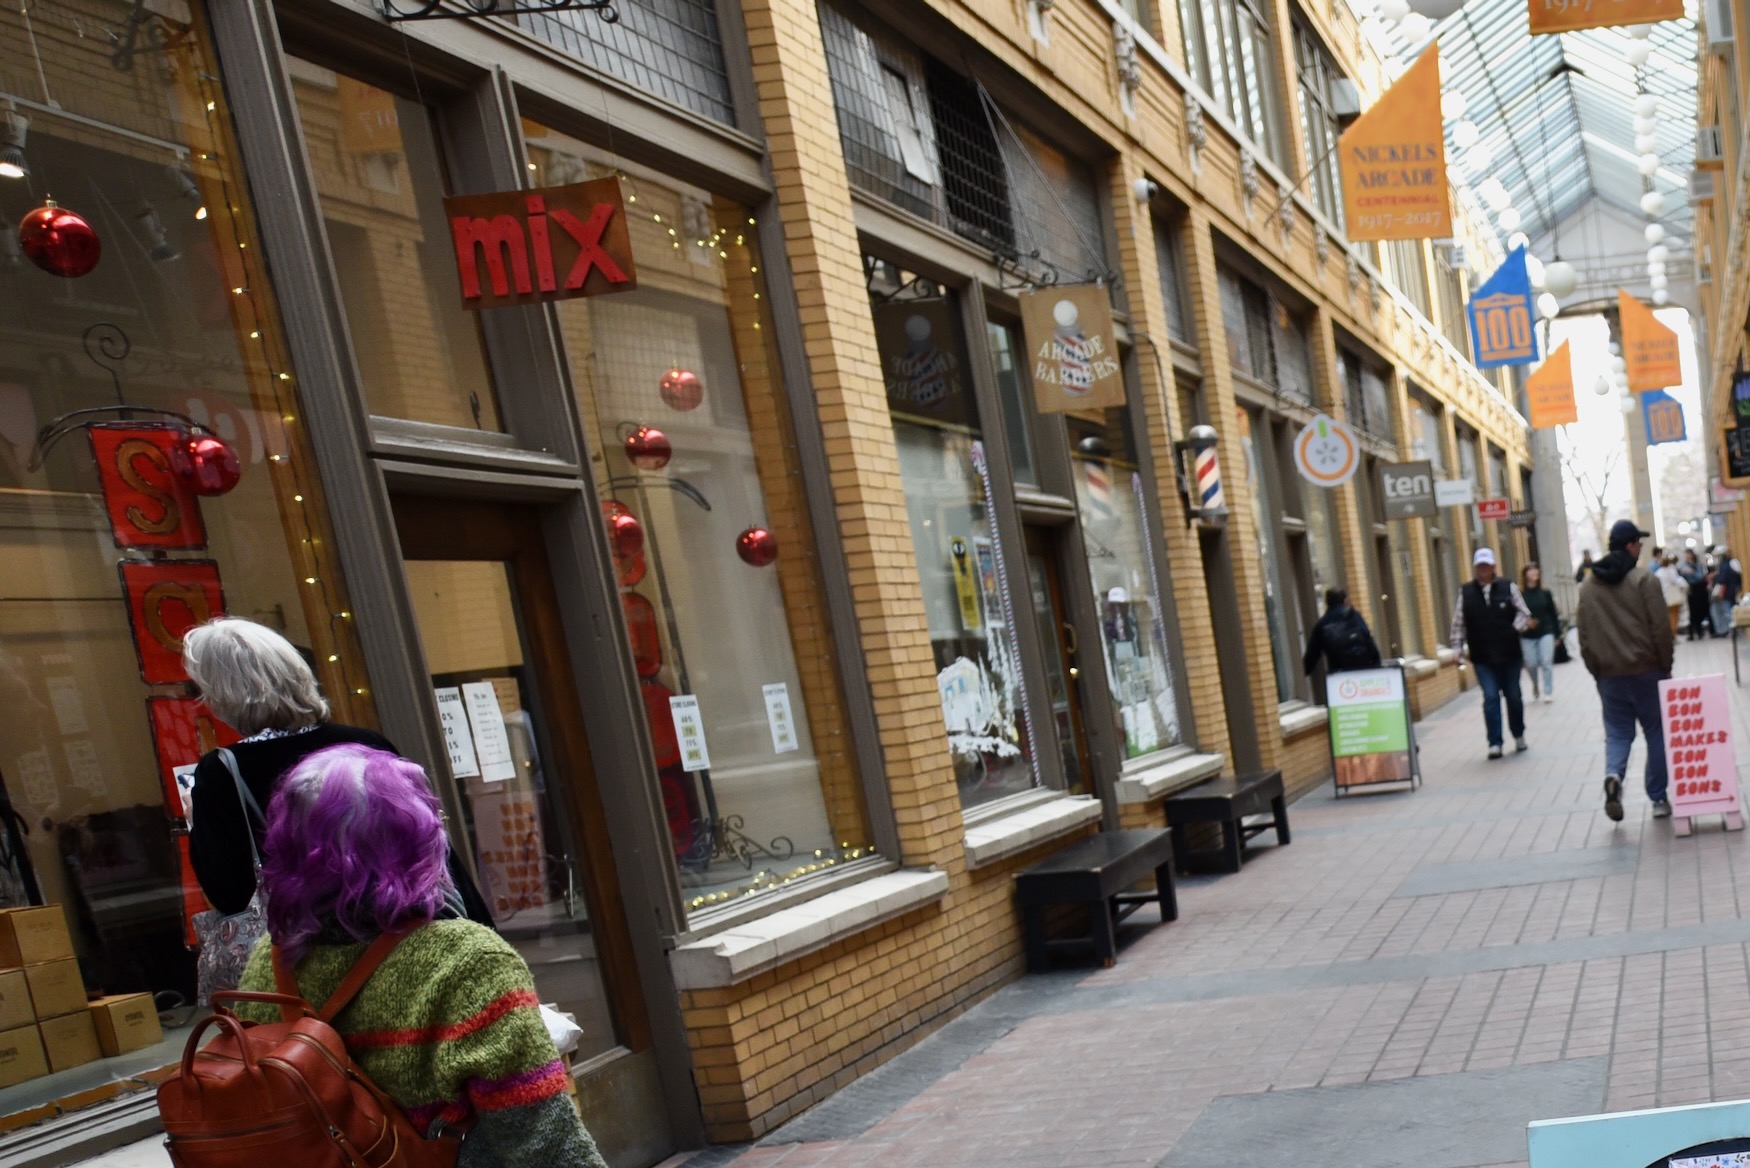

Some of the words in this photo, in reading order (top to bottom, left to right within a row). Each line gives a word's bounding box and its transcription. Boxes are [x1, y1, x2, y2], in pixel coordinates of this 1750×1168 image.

[1352, 143, 1438, 165] NICKELS
[1356, 167, 1438, 190] ARCADE
[453, 195, 629, 298] mix
[1477, 306, 1532, 352] 100
[1383, 473, 1431, 498] ten
[1667, 686, 1701, 702] BON
[1668, 701, 1702, 718] BON
[1670, 717, 1704, 733] BON
[1670, 730, 1728, 748] MAKES
[1673, 749, 1707, 765] BON
[1674, 764, 1708, 780] BON
[1676, 779, 1722, 797] BONS
